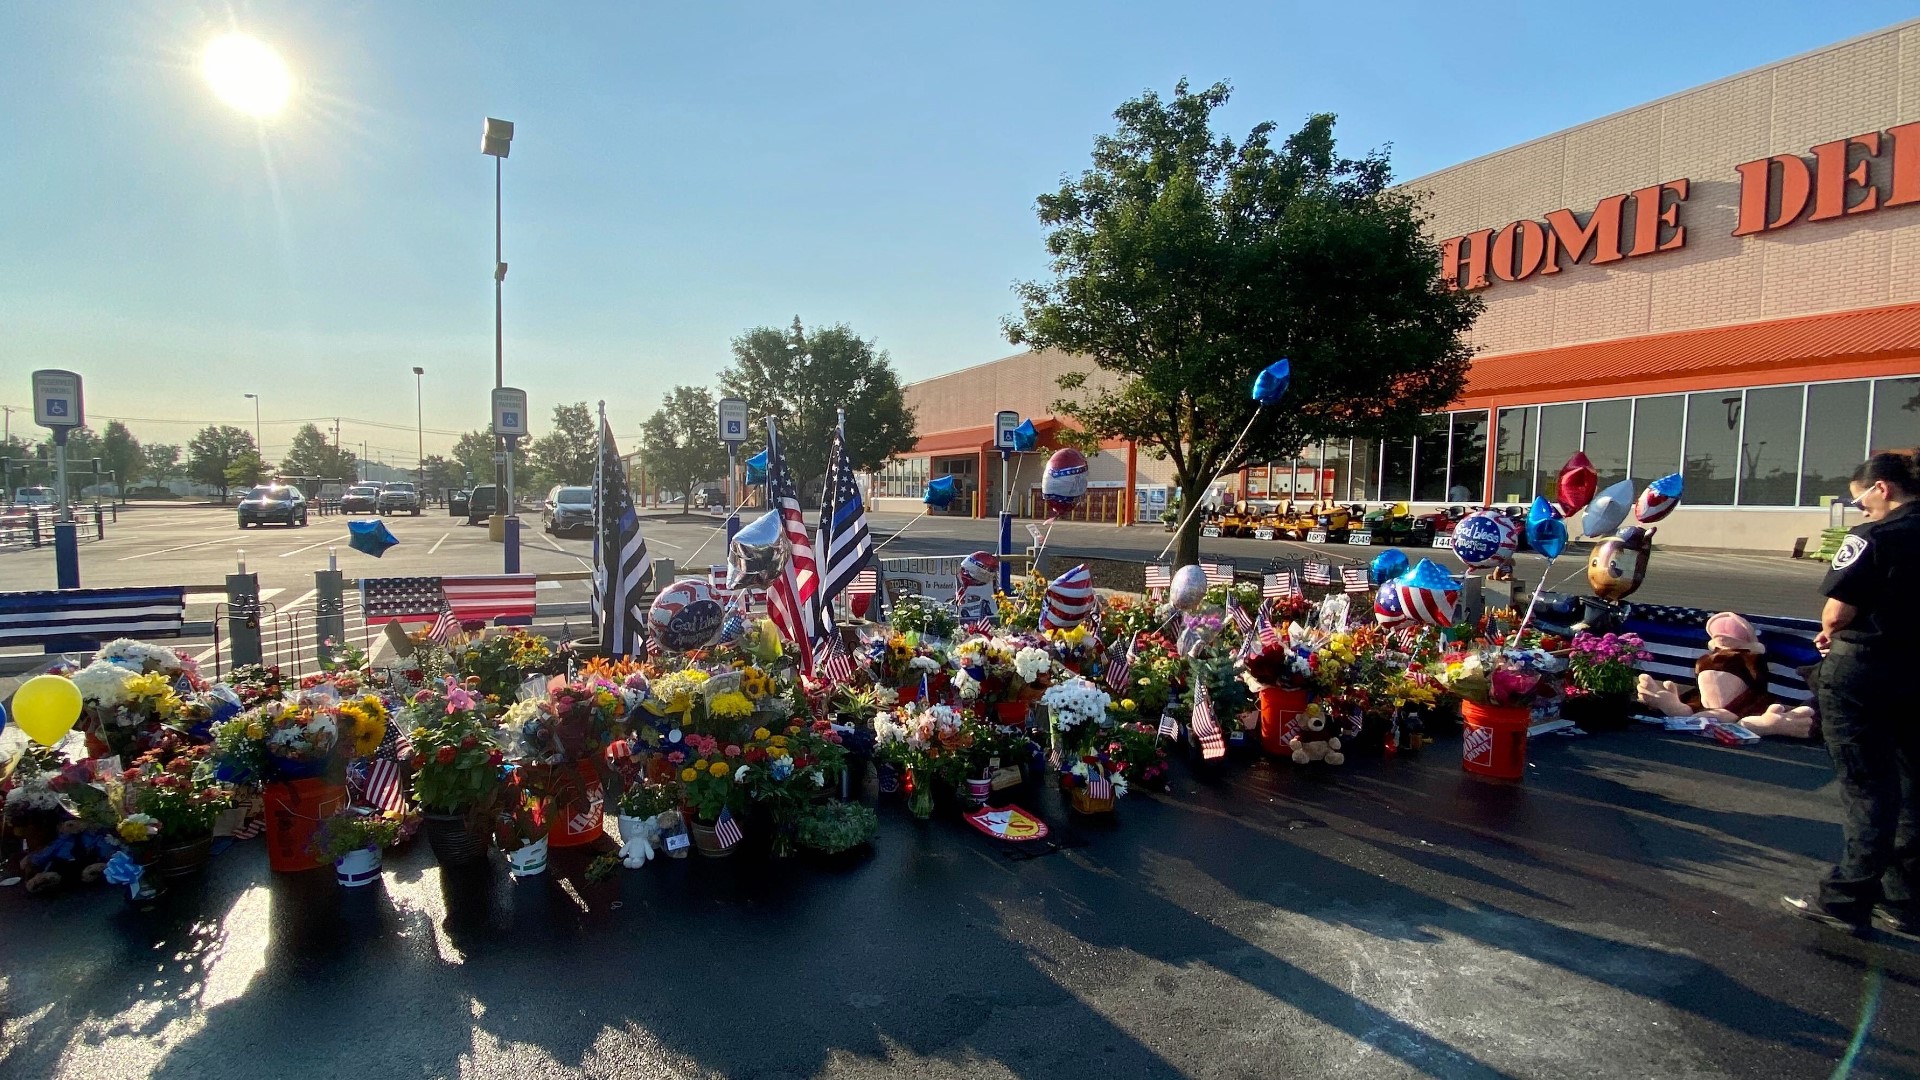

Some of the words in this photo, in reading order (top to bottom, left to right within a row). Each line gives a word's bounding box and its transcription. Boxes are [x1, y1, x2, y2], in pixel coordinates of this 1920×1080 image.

[1440, 178, 1690, 291] HOME
[1349, 534, 1371, 543] 2349
[890, 579, 918, 589] TOLEDO
